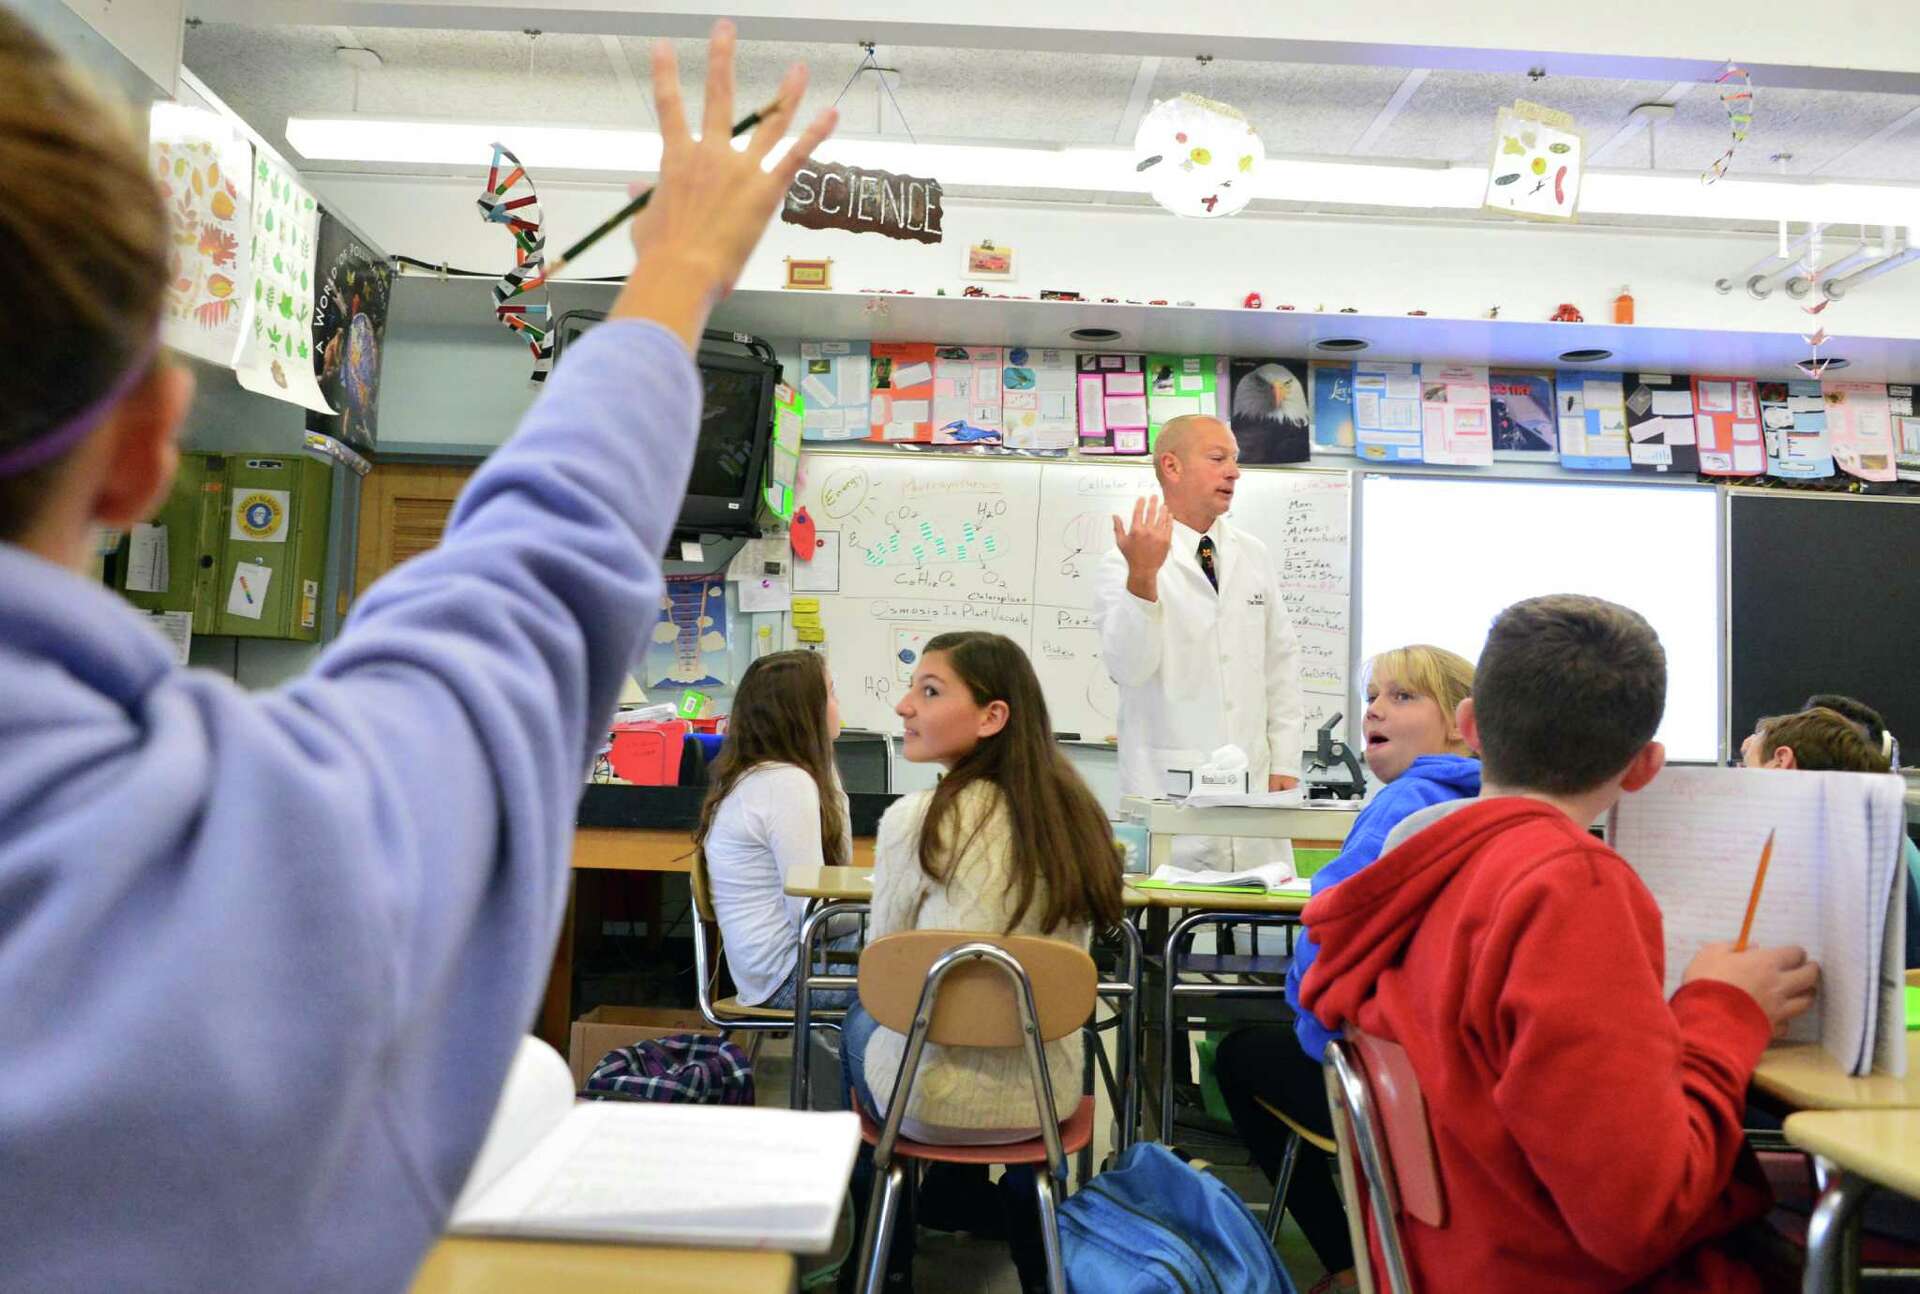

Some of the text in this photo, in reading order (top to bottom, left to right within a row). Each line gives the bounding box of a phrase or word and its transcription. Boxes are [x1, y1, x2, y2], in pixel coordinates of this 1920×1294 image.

[789, 169, 943, 235] SCIENCE
[313, 266, 339, 327] WORLD
[315, 340, 325, 354] A
[976, 500, 1008, 520] H2O
[870, 600, 939, 617] Osmosis
[864, 675, 891, 697] H2O
